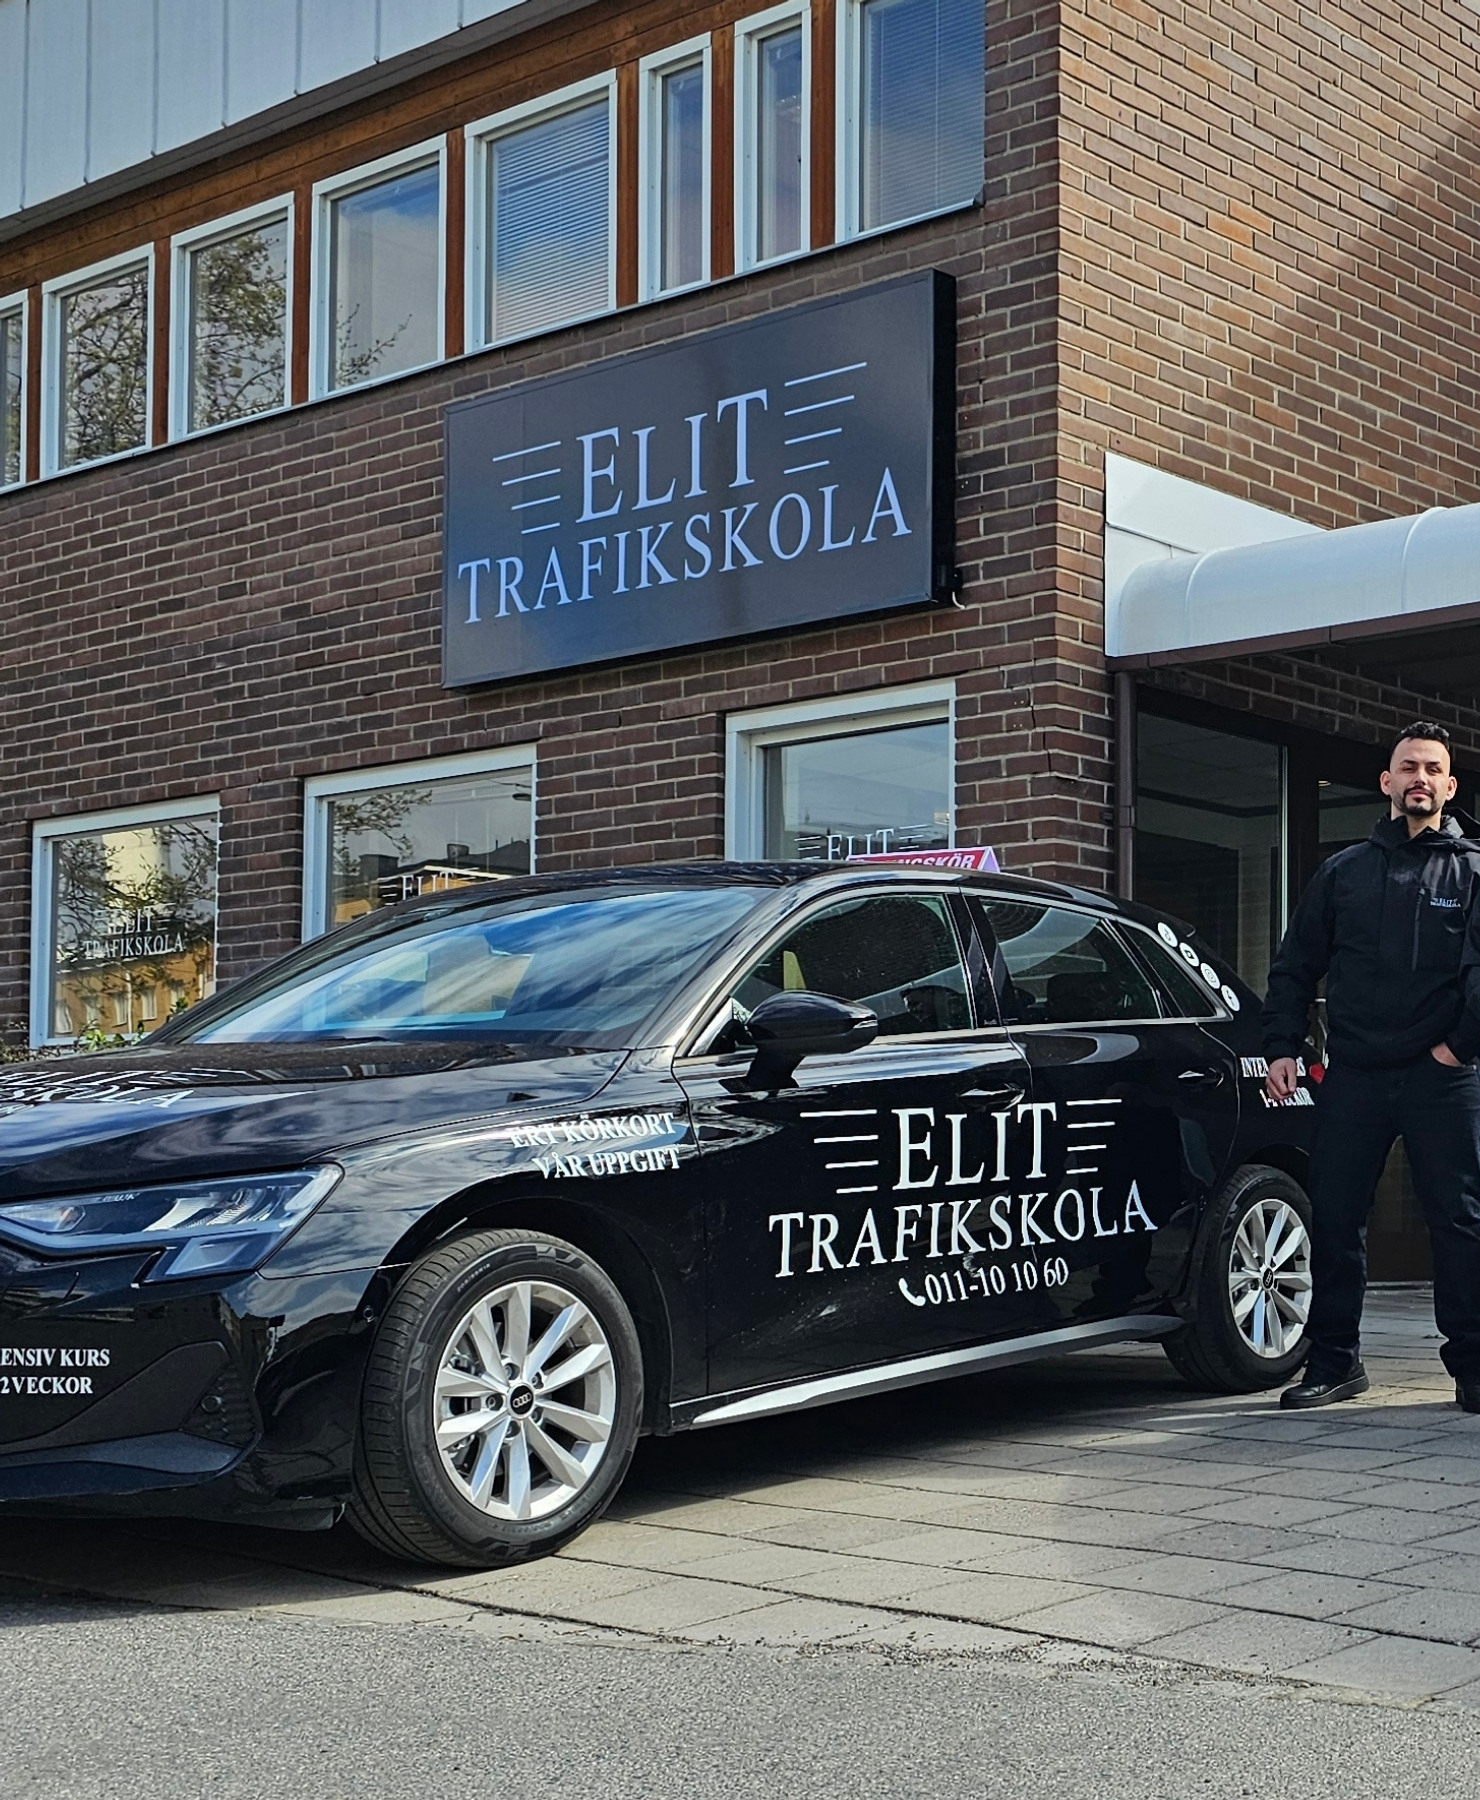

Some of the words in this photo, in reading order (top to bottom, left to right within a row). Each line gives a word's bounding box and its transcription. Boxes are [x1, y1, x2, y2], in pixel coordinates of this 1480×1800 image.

[575, 387, 769, 524] ELIT
[457, 466, 912, 625] TRAFIKSKOLA
[83, 932, 184, 959] TRAFIKSKOLA
[509, 1124, 559, 1148] ERT
[559, 1113, 677, 1143] KÖRKORT
[891, 1102, 1057, 1191] ELIT
[531, 1151, 588, 1179] VÅR
[586, 1147, 680, 1176] UPPGIFT
[768, 1179, 1158, 1278] TRAFIKSKOLA
[925, 1264, 1006, 1305] 011-10
[1010, 1261, 1038, 1292] 10
[1044, 1256, 1069, 1287] 60
[60, 1348, 110, 1366] KURS
